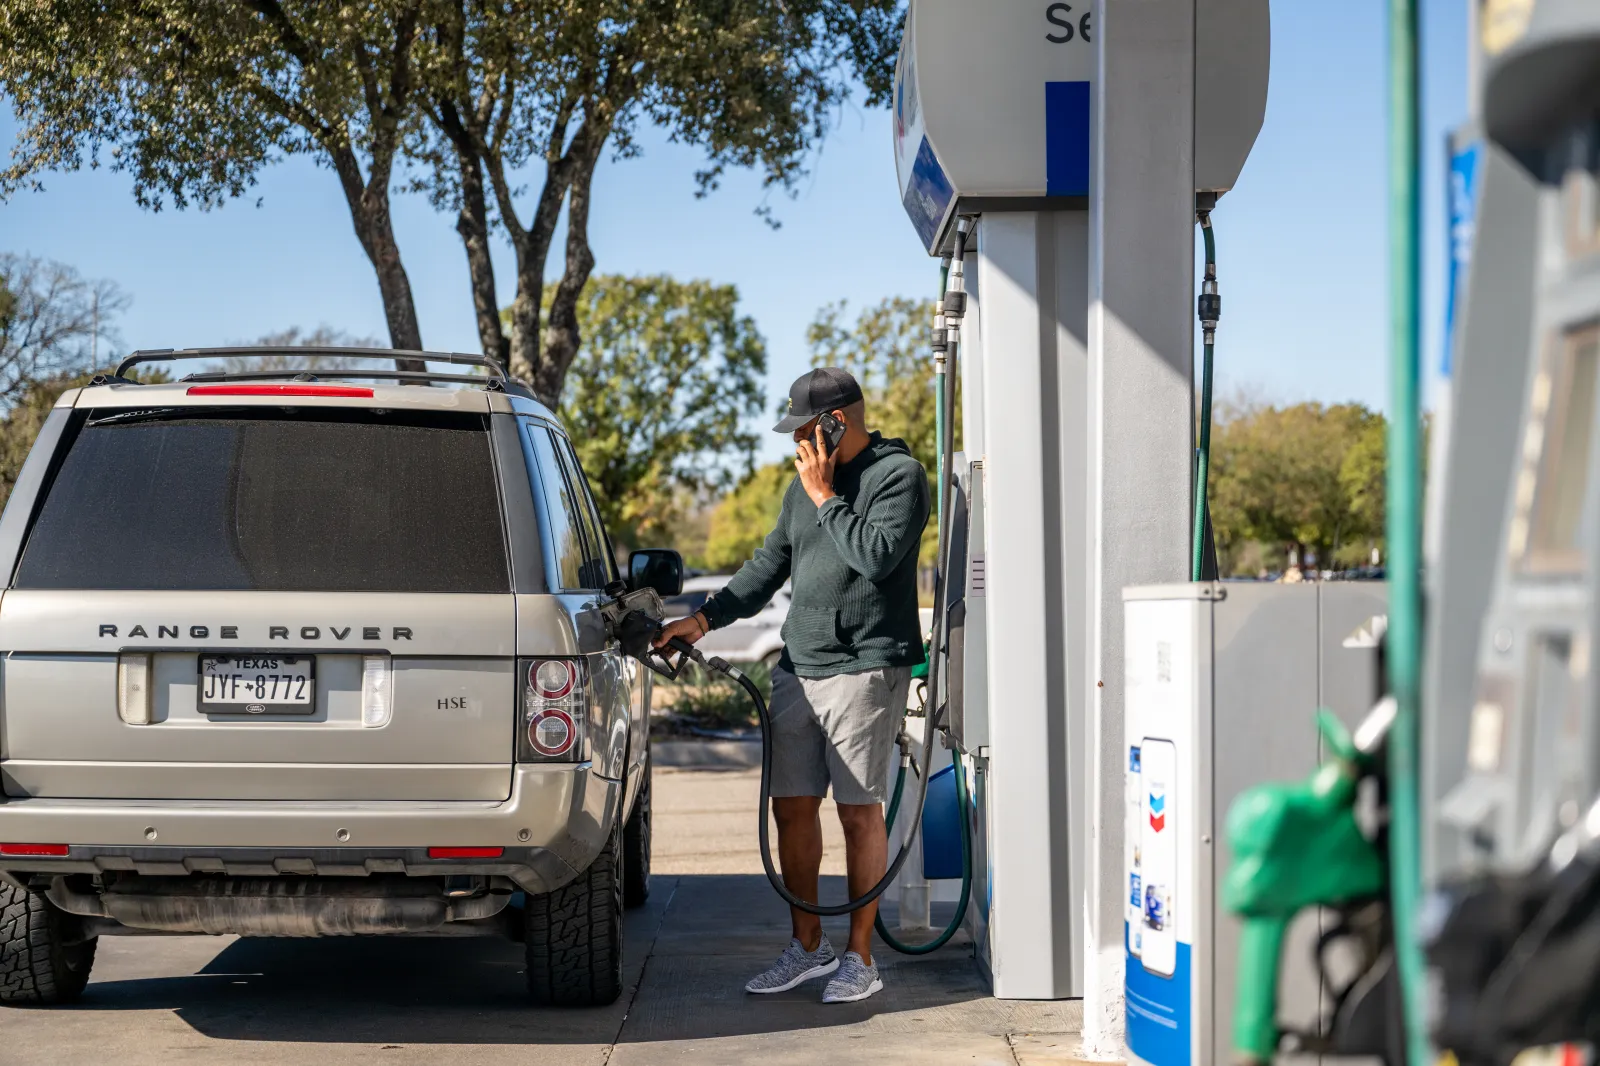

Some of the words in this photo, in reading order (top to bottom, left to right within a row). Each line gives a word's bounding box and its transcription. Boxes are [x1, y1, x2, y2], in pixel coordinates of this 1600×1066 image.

[98, 624, 239, 639] RANGE
[269, 626, 413, 640] ROVER
[235, 659, 279, 669] TEXAS
[204, 673, 242, 699] JYF
[255, 674, 306, 700] 8772
[437, 696, 467, 710] HSE
